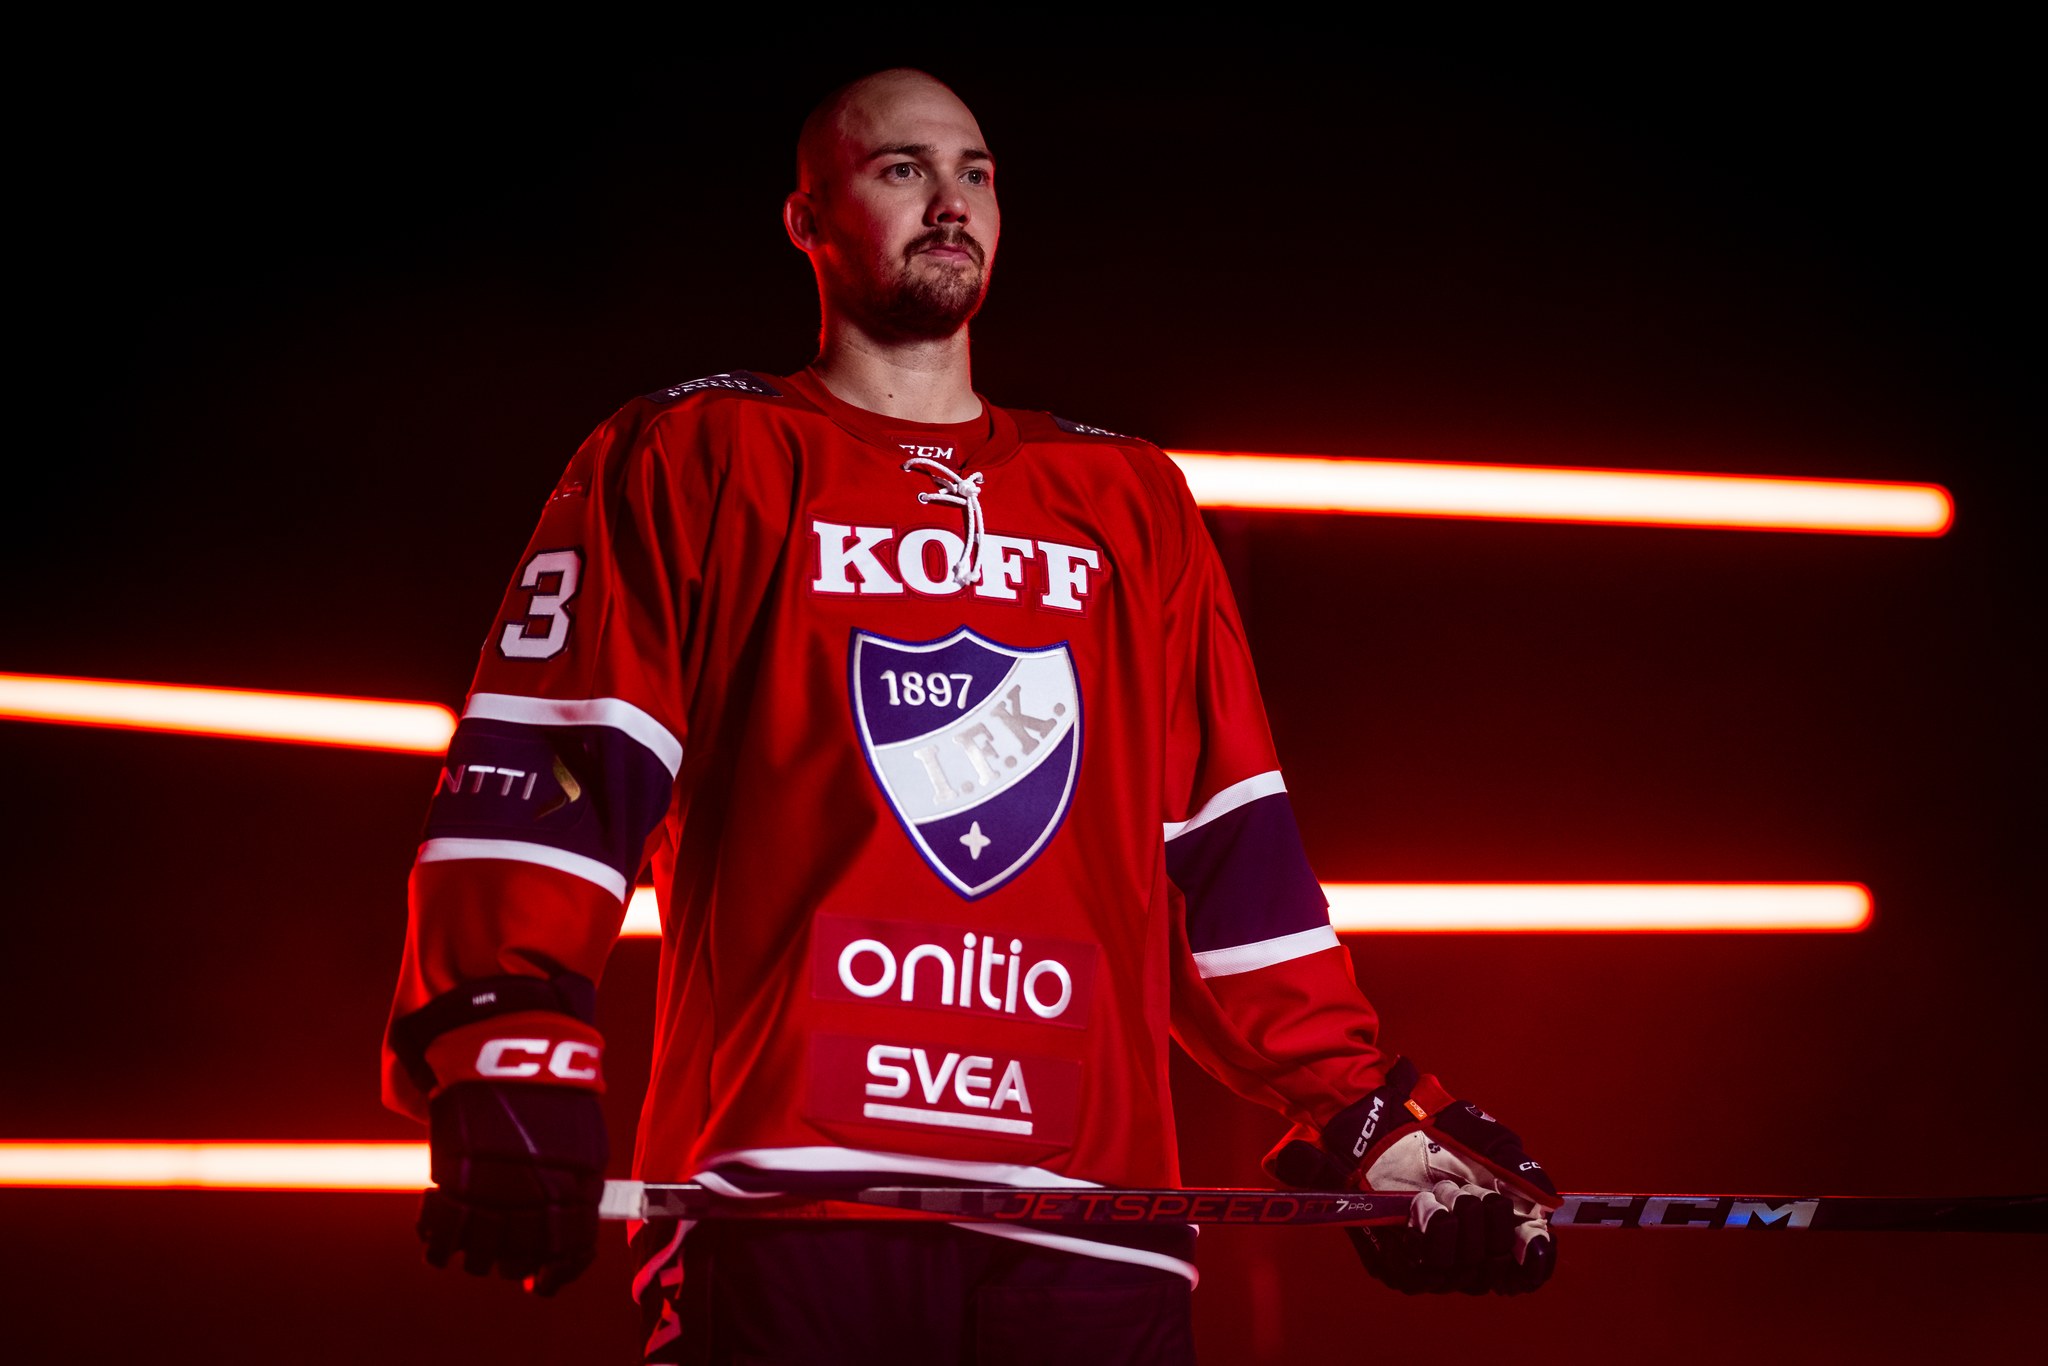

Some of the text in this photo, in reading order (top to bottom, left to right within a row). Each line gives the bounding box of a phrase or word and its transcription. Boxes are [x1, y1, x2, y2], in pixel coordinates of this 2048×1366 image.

[812, 519, 1099, 612] KOFF
[499, 548, 583, 660] 3
[880, 669, 973, 710] 1897
[837, 931, 1073, 1019] onitio
[864, 1043, 1033, 1114] SVEA
[1352, 1096, 1385, 1158] CCM
[993, 1192, 1297, 1223] JETSPEED
[1550, 1195, 1820, 1229] CCM
